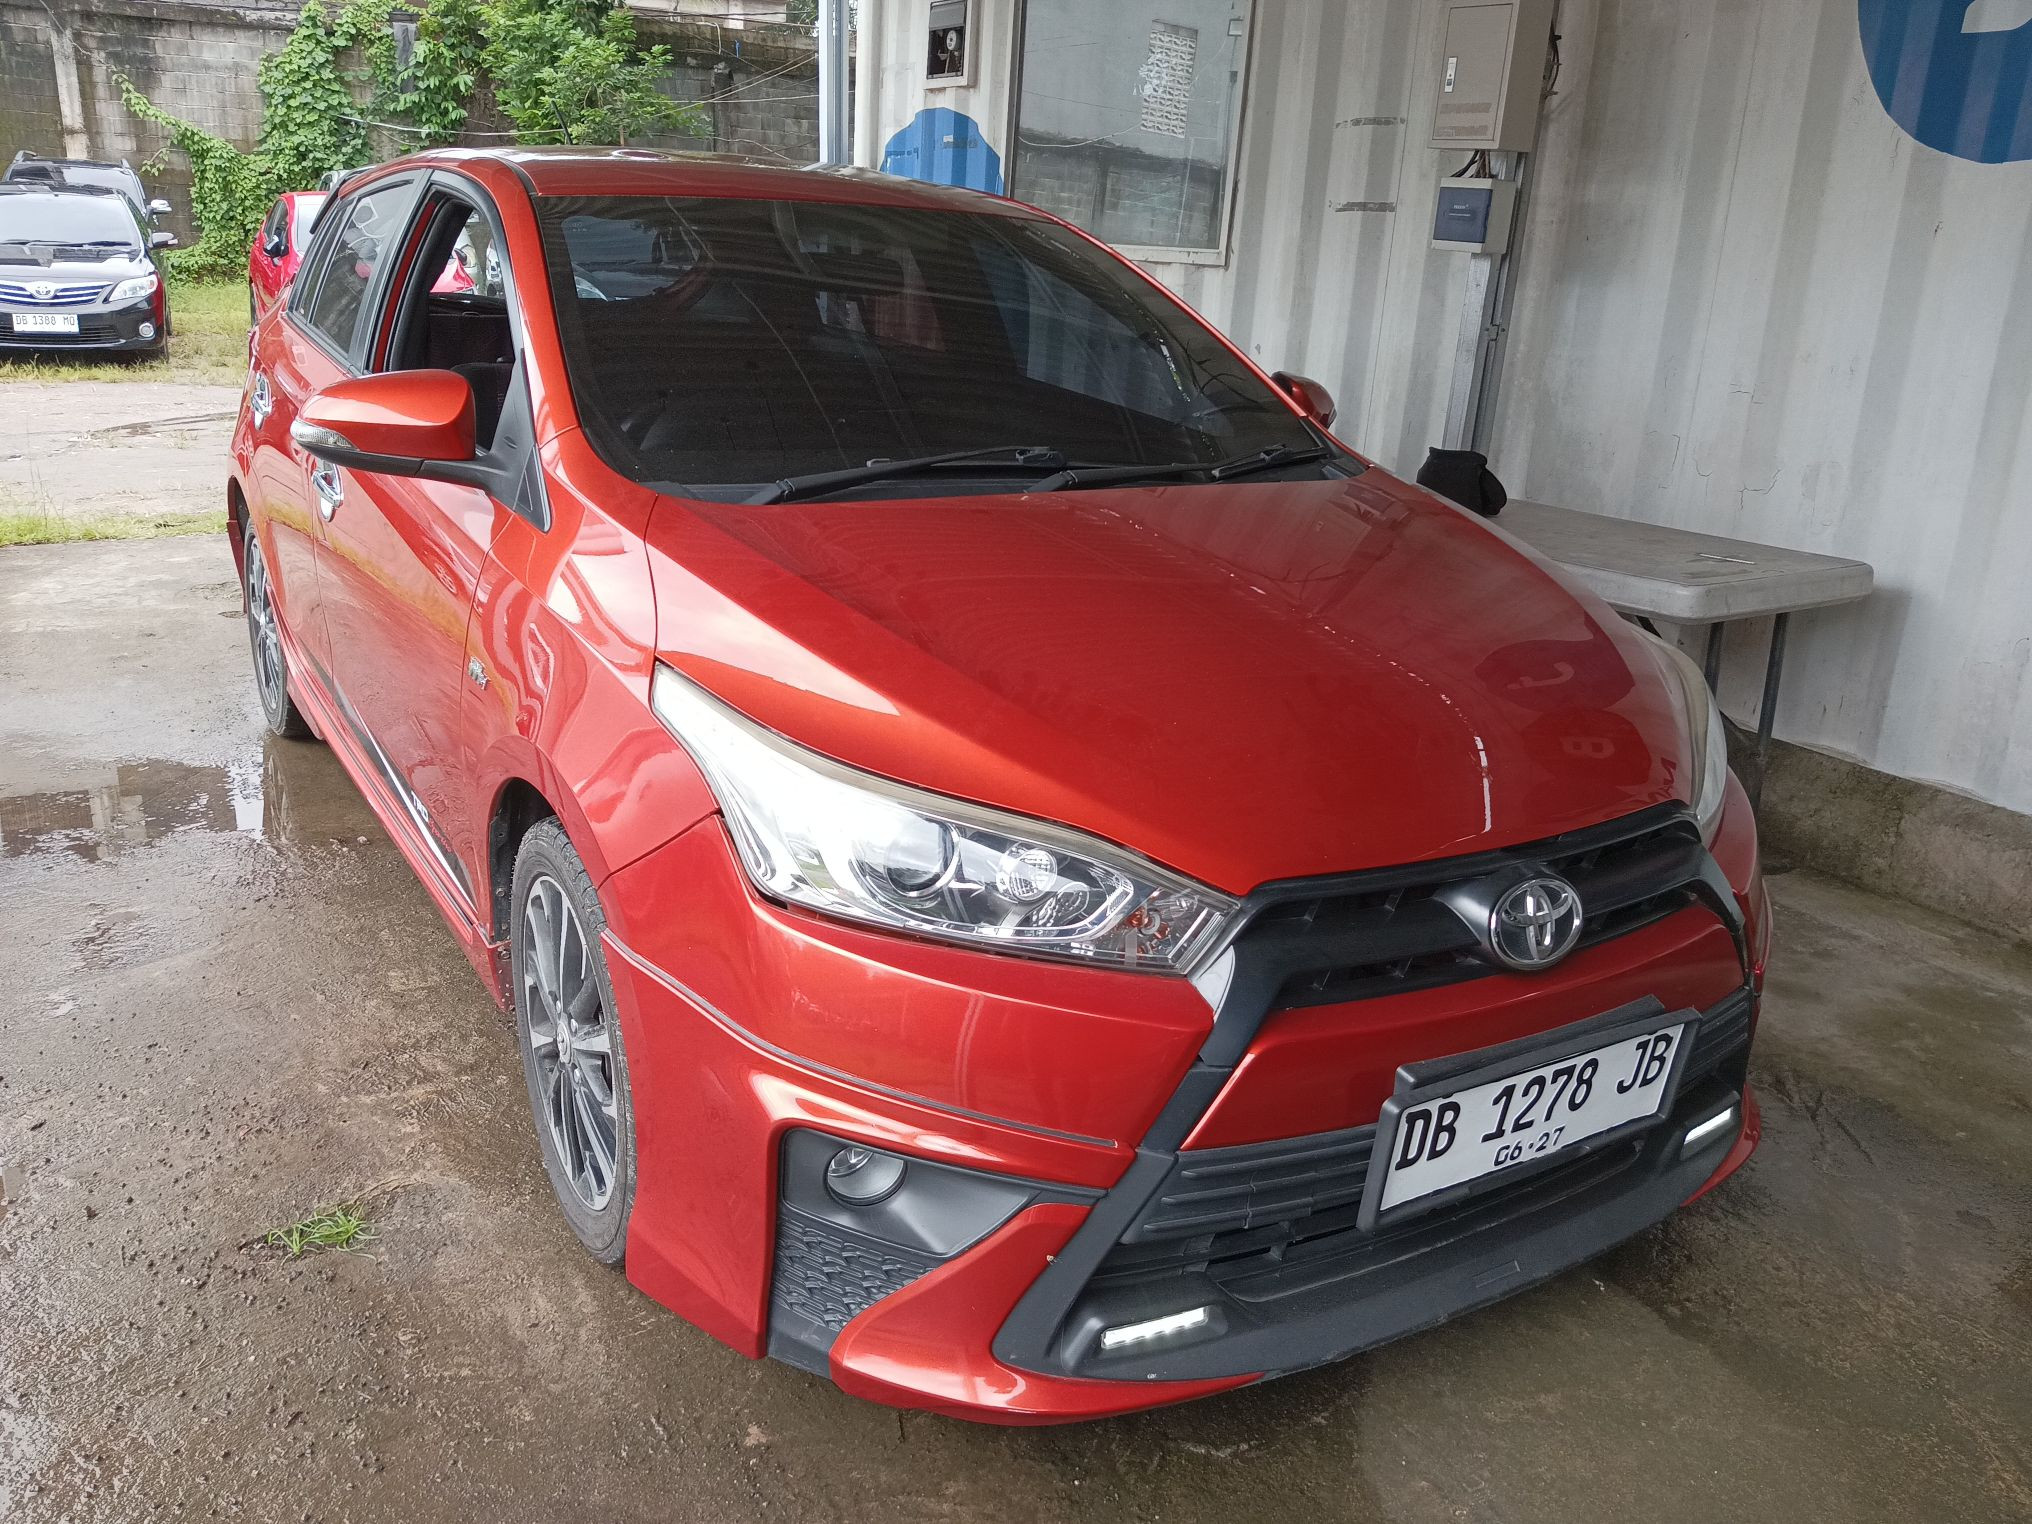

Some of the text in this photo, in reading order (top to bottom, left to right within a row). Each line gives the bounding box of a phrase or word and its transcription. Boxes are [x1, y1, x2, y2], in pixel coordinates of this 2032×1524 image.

[15, 315, 28, 325] DB
[1394, 1031, 1674, 1171] DB 1278 JB
